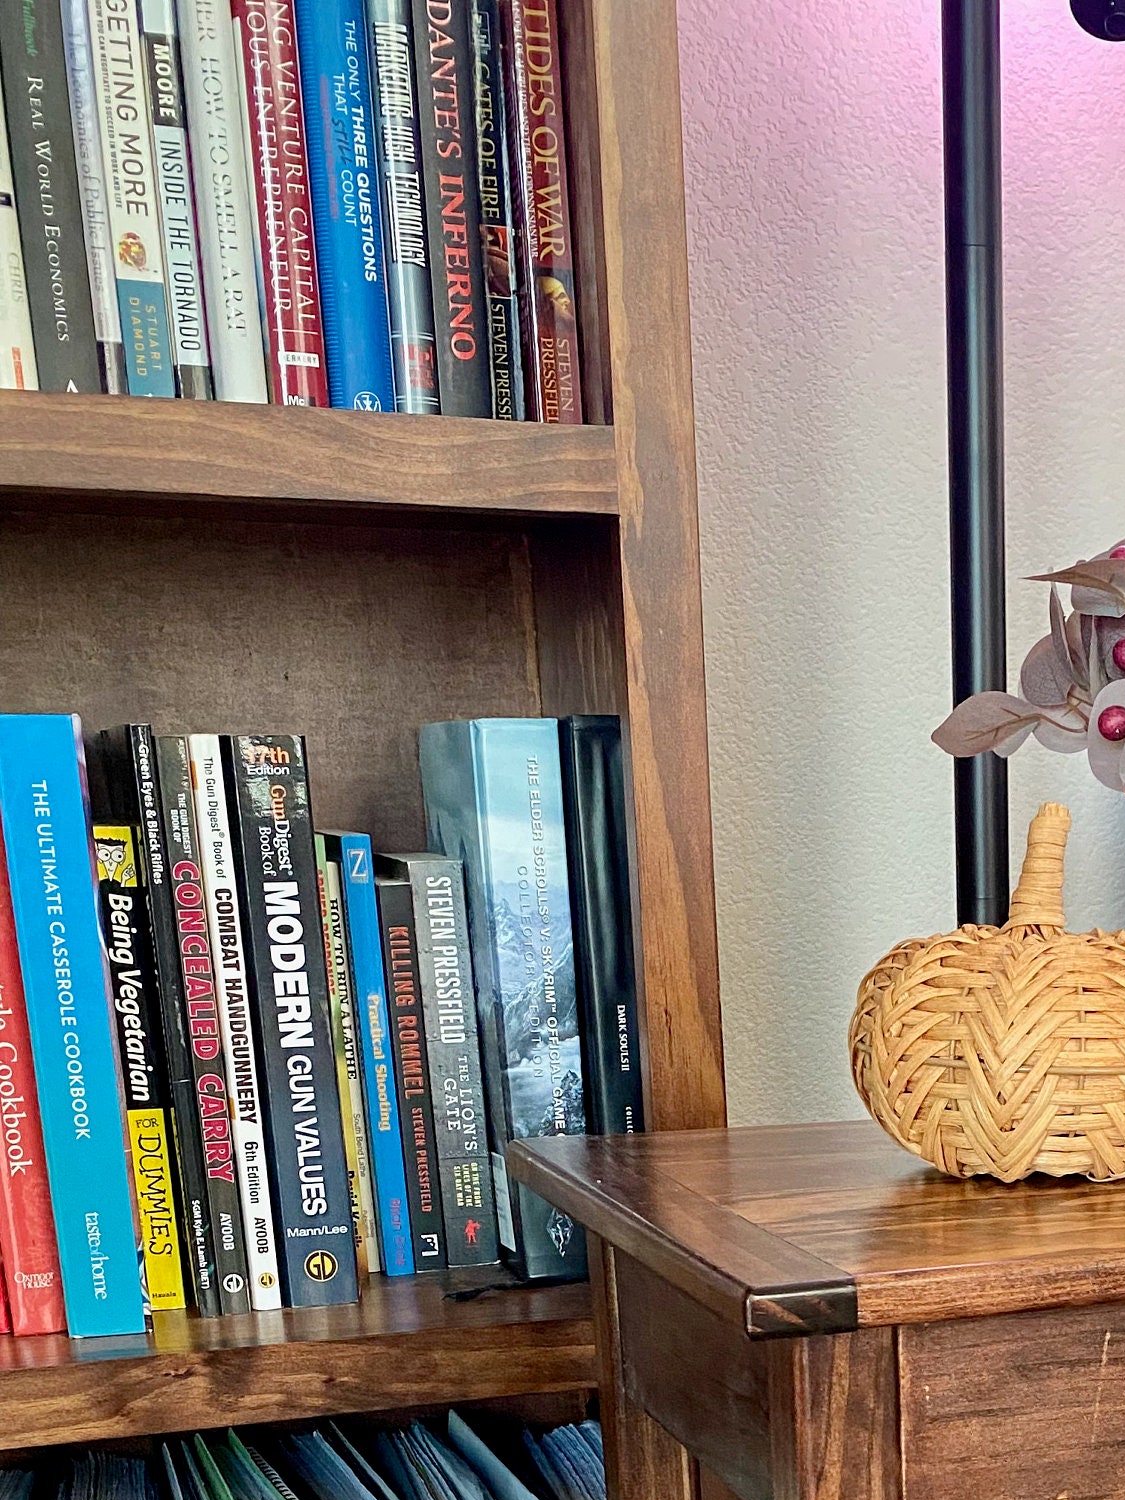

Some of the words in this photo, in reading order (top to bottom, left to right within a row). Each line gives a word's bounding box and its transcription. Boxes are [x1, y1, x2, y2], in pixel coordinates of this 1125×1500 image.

[98, 36, 106, 51] CAN
[344, 20, 357, 52] THE
[523, 0, 555, 116] TIDES
[100, 53, 111, 92] NEGOTIATE
[106, 0, 138, 122] GETTING
[153, 43, 178, 120] MOORE
[347, 56, 361, 101] ONLY
[374, 21, 413, 118] MARKETING
[426, 0, 462, 159] DANTE'S
[104, 94, 112, 104] TO
[200, 56, 225, 122] HOW
[333, 73, 347, 116] THAT
[105, 106, 116, 139] SUCCEED
[276, 61, 305, 195] VENTURE
[331, 116, 352, 166] STILL
[351, 106, 369, 169] THREE
[383, 125, 415, 164] HIGH
[110, 150, 120, 174] WORK
[208, 127, 230, 166] TO
[479, 137, 496, 170] OF
[532, 126, 560, 173] OF
[82, 164, 101, 184] of
[113, 176, 121, 191] AND
[119, 133, 149, 217] MORE
[160, 140, 187, 205] INSIDE
[84, 187, 106, 240] Public
[213, 173, 239, 259] SMELL
[253, 86, 292, 314] ENTREPRENEUR
[341, 170, 358, 227] COUNT
[386, 171, 426, 267] TECHNOLOGY
[534, 178, 566, 262] WAR
[168, 216, 191, 250] THE
[356, 172, 378, 282] QUESTIONS
[91, 245, 106, 291] Issues
[222, 265, 241, 281] A
[289, 207, 316, 324] CAPITAL
[438, 171, 476, 361] INFERNO
[172, 261, 202, 351] TORNADO
[224, 287, 247, 333] RAT
[129, 297, 148, 377] DIAMOND
[145, 305, 163, 371] STUART
[491, 303, 509, 365] STEVEN
[556, 338, 574, 412] STEVEN
[138, 743, 151, 779] Green
[203, 757, 214, 775] The
[246, 764, 291, 776] Edition
[526, 754, 540, 786] THE
[31, 779, 51, 817] THE
[140, 781, 154, 807] Eyes
[178, 793, 187, 807] THE
[205, 778, 217, 798] Gun
[146, 809, 157, 819] &
[147, 820, 160, 853] Black
[171, 809, 180, 831] BOOK
[173, 831, 182, 843] OF
[179, 808, 188, 826] GUN
[529, 789, 545, 842] ELDER
[213, 841, 225, 867] Book
[259, 826, 275, 861] Book
[350, 850, 368, 878] Z
[36, 823, 63, 916] ULTIMATE
[151, 853, 163, 885] Rifles
[216, 869, 227, 879] of
[262, 861, 277, 877] of
[107, 893, 138, 965] Being
[214, 888, 240, 972] COMBAT
[330, 898, 342, 940] HOW
[425, 876, 456, 940] STEVEN
[49, 921, 78, 1027] CASSEROLE
[263, 881, 315, 1049] MODERN
[334, 944, 345, 967] TO
[388, 926, 416, 1007] KILLING
[432, 945, 468, 1045] PRESSFIELD
[617, 1004, 627, 1032] DARK
[114, 969, 154, 1102] Vegetarian
[173, 860, 219, 1061] CONCEALED
[197, 1073, 235, 1183] CARRY
[367, 994, 385, 1060] Practical
[529, 1004, 544, 1078] EDITION
[225, 978, 258, 1124] HANDGUNNERY
[342, 1023, 358, 1079] LATHE
[397, 1015, 425, 1100] ROMMEL
[458, 1055, 469, 1082] THE
[546, 1017, 562, 1084] OFFICIAL
[618, 1033, 630, 1064] SOULS
[63, 1032, 91, 1140] COOKBOOK
[286, 1054, 317, 1113] GUN
[374, 1063, 392, 1132] Shooting
[443, 1077, 461, 1131] GATE
[0, 1041, 33, 1177] Cookbook
[136, 1118, 159, 1129] FOR
[353, 1113, 362, 1135] South
[411, 1107, 426, 1147] STEVEN
[460, 1088, 478, 1151] LION'S
[552, 1087, 567, 1130] GAME
[244, 1141, 259, 1162] 6th
[294, 1116, 328, 1217] VALUES
[356, 1136, 364, 1155] Bend
[138, 1133, 174, 1256] DUMMIES
[247, 1165, 261, 1204] Edition
[416, 1149, 433, 1213] PRESSFIELD
[192, 1199, 202, 1219] SGM
[219, 1212, 235, 1251] AYOOB
[286, 1224, 348, 1239] Mann/Lee
[254, 1217, 269, 1254] AYOOB
[14, 1271, 54, 1284] Oxmoor
